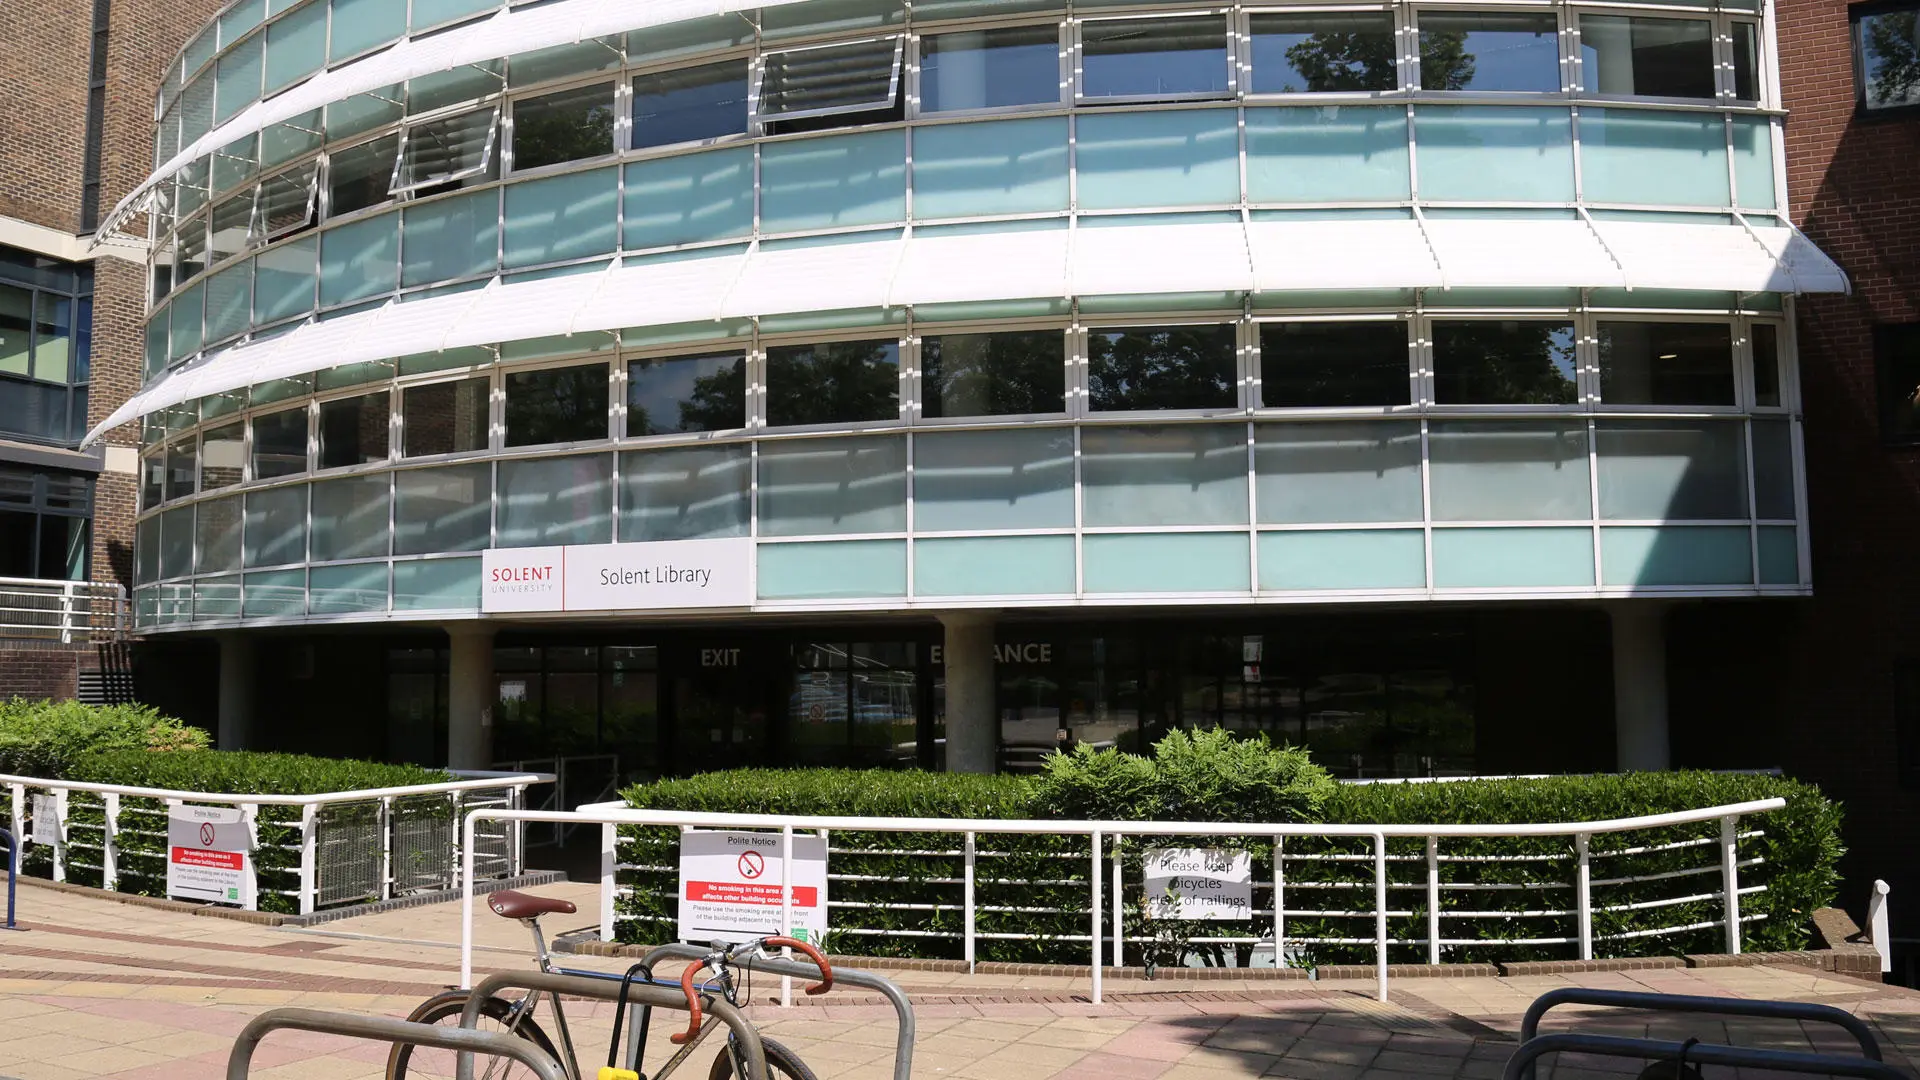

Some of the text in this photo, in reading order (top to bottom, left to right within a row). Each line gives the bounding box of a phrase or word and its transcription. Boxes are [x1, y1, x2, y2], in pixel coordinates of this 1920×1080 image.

[492, 566, 553, 582] SOLENT
[600, 566, 711, 588] Solent Library
[492, 584, 553, 594] UNIVERSITY
[701, 648, 740, 666] EXIT
[930, 643, 1052, 664] EANCE
[727, 836, 776, 846] Polite Notice
[1160, 860, 1234, 874] Please keep
[718, 885, 744, 894] smoking
[741, 895, 766, 904] building
[1184, 895, 1197, 905] of
[1201, 895, 1246, 908] railings
[735, 907, 761, 915] smoking
[714, 914, 737, 923] building
